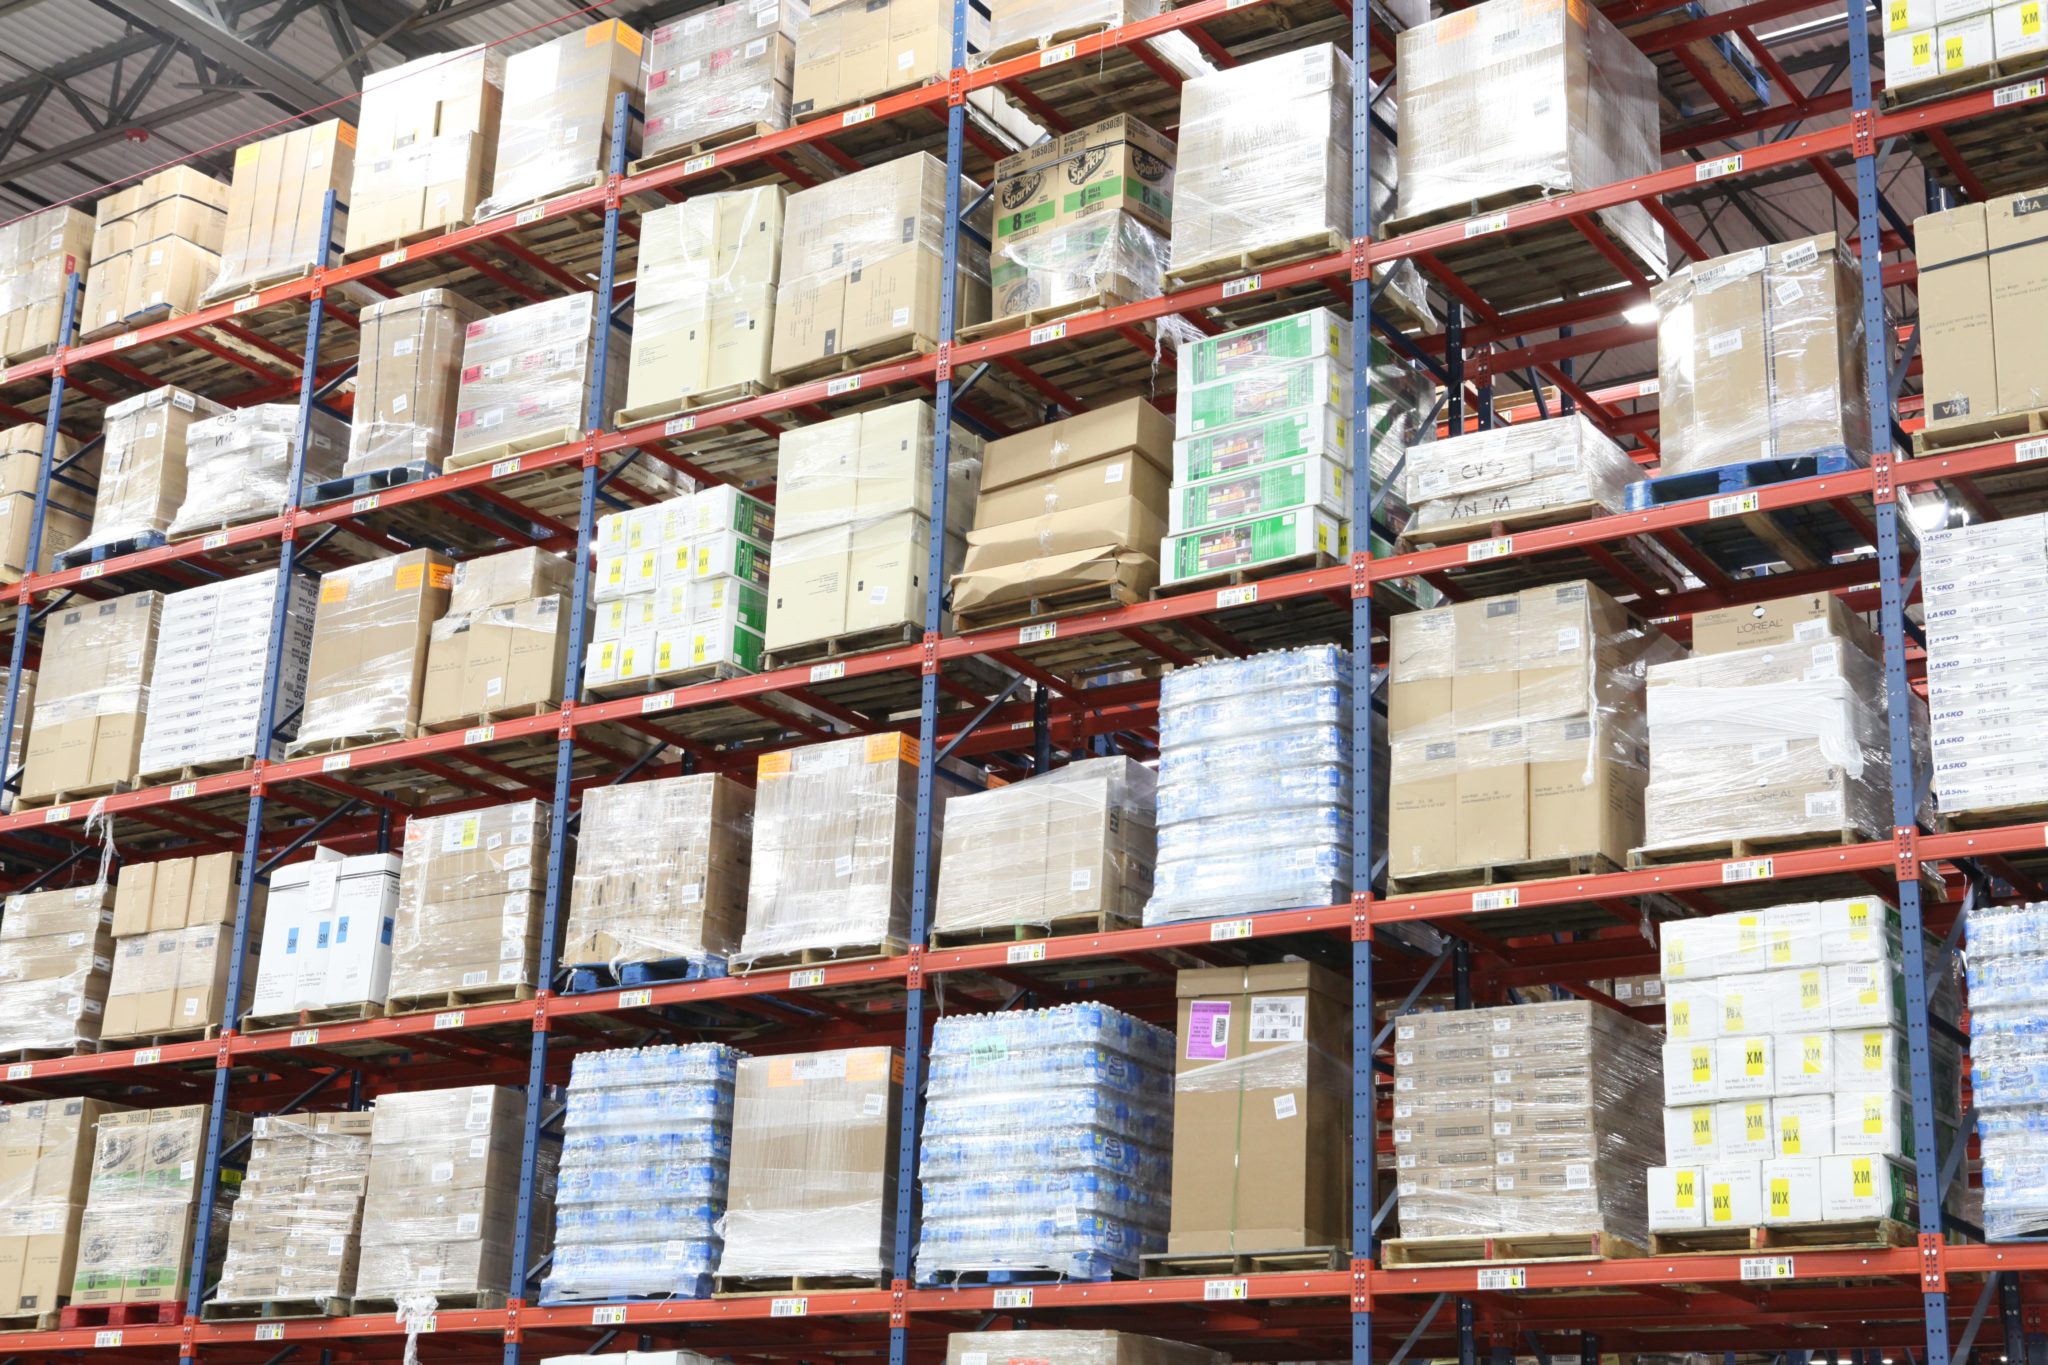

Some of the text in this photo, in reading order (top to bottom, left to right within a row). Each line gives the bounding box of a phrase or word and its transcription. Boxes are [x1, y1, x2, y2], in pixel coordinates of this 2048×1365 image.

[2023, 12, 2038, 24] XM
[1913, 44, 1928, 55] XM
[2029, 87, 2037, 96] H
[1135, 156, 1165, 179] Sparkle
[1728, 163, 1735, 171] W
[1004, 173, 1040, 207] Sparkle
[1013, 213, 1021, 231] 8
[1462, 460, 1504, 478] CVS
[678, 552, 687, 560] XM
[644, 559, 653, 567] XM
[611, 567, 620, 575] XM
[1927, 609, 1956, 619] LASKO
[603, 651, 612, 659] XM
[1930, 660, 1959, 670] LASKO
[1934, 710, 1963, 720] LASKO
[1934, 736, 1964, 746] LASKO
[1937, 761, 1967, 771] LASKO
[1850, 914, 1867, 927] XM
[319, 934, 328, 944] SM
[1802, 983, 1818, 996] XM
[1804, 1047, 1821, 1060] XM
[1864, 1044, 1880, 1058] XM
[1693, 1057, 1709, 1070] XM
[1746, 1051, 1762, 1064] XM
[1864, 1108, 1880, 1120] XM
[1694, 1120, 1709, 1132] XM
[1747, 1115, 1763, 1128] XM
[1853, 1171, 1870, 1184] XM
[1677, 1183, 1693, 1195] XM
[1512, 1277, 1517, 1285] L
